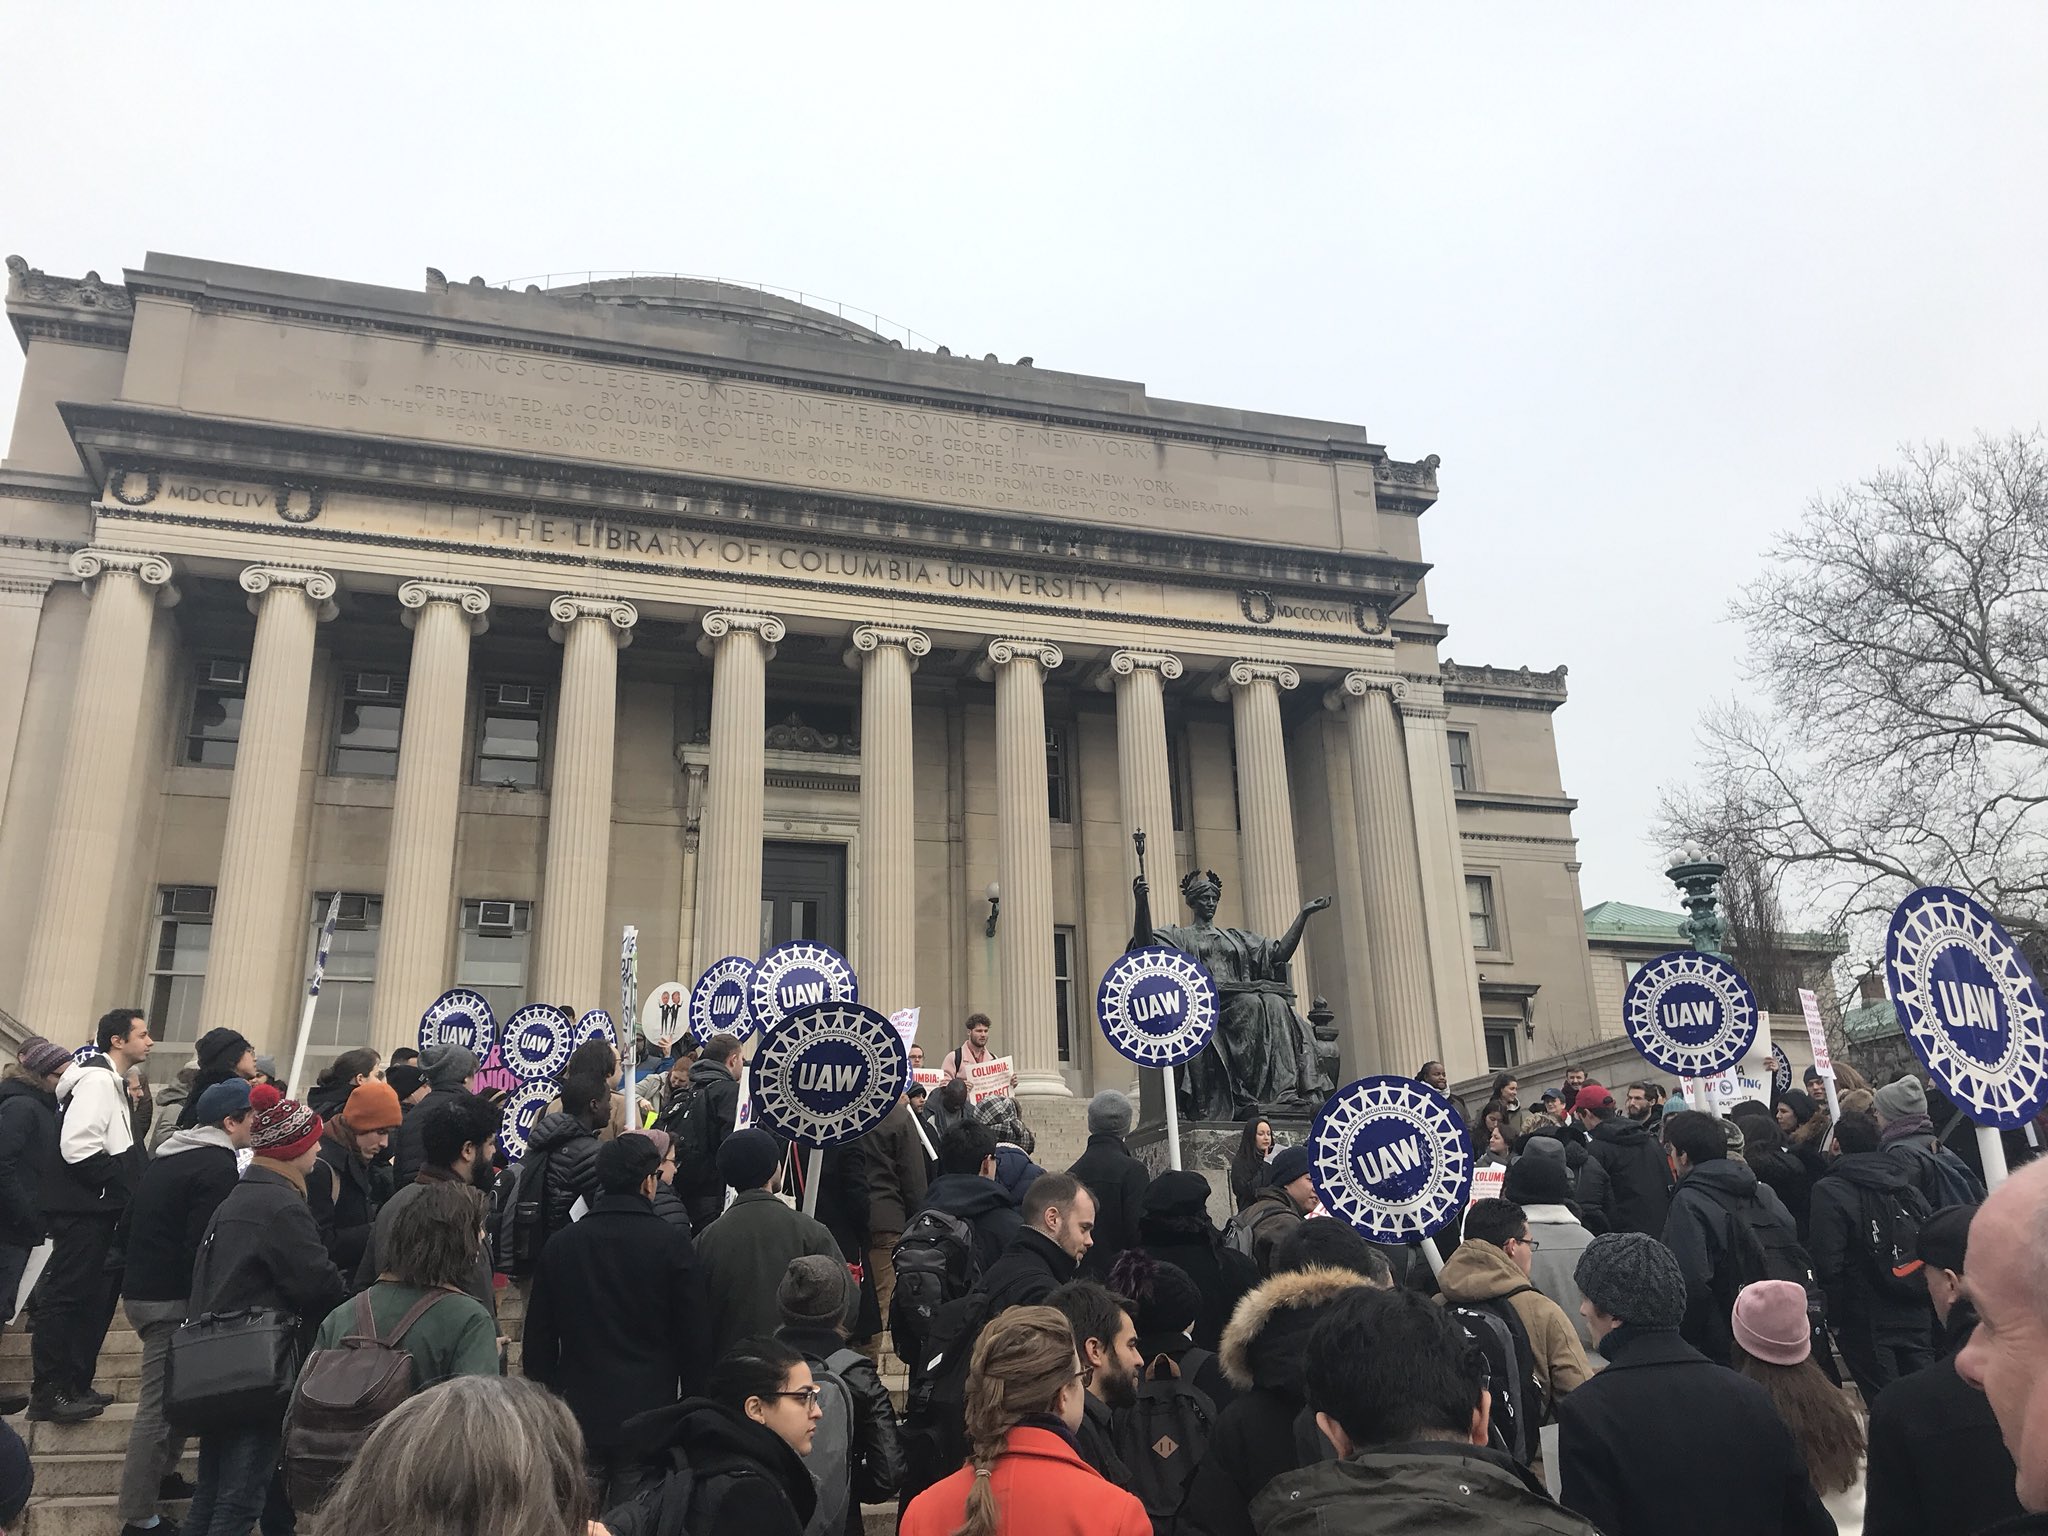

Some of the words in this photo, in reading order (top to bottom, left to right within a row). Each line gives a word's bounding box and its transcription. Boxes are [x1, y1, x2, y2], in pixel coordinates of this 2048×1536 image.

[541, 363, 651, 392] COLLEGE
[665, 380, 775, 409] FOUNDED
[789, 397, 811, 415] IN
[823, 402, 869, 423] THE
[882, 410, 987, 438] PROVINCE
[1000, 426, 1026, 442] OF
[1037, 432, 1083, 449] NEW
[601, 391, 623, 404] BY
[633, 395, 688, 415] ROYAL
[697, 405, 774, 426] CHARTER
[785, 415, 801, 428] IN
[810, 420, 844, 436] THE
[854, 425, 902, 443] REIGN
[912, 434, 934, 447] OF
[943, 437, 1002, 457] GEORGE
[414, 384, 543, 413] PERPETUATED
[551, 403, 574, 417] AS
[583, 404, 694, 434] COLUMBIA
[703, 420, 798, 446] COLLEGE
[807, 435, 827, 450] BY
[835, 439, 868, 456] THE
[878, 445, 934, 464] PEOPLE
[942, 453, 965, 467] OF
[971, 457, 1003, 473] THE
[1012, 462, 1056, 479] STATE
[1063, 468, 1084, 482] OF
[1091, 472, 1125, 486] NEW
[1134, 477, 1176, 495] YORK
[167, 485, 269, 508] MDCCLIV
[492, 515, 555, 543] THE
[575, 523, 706, 559] LIBRARY
[720, 541, 762, 565] OF
[778, 548, 932, 585] COLUMBIA
[947, 564, 1112, 603] UNIVERSITY
[713, 995, 740, 1015] UAW
[781, 981, 824, 1009] UAW
[1133, 990, 1179, 1021] UAW
[1938, 980, 1998, 1031] UAW
[1663, 1001, 1714, 1028] UAW
[2009, 993, 2022, 1032] WORKERS
[441, 1025, 474, 1046] UAW
[520, 1033, 551, 1053] UAW
[823, 1029, 863, 1042] AGRICULTURAL
[798, 1062, 862, 1092] UAW
[971, 1062, 1009, 1077] COLUMBIA:
[1347, 1120, 1358, 1131] AND
[1358, 1106, 1399, 1119] AGRICULTURAL
[1400, 1107, 1430, 1129] IMPLEMENT
[1339, 1133, 1348, 1165] AEROSPACE
[1430, 1130, 1443, 1158] WORKERS
[1357, 1134, 1421, 1185] UAW
[1428, 1170, 1442, 1194] AMERICA
[1365, 1200, 1387, 1212] UNITED
